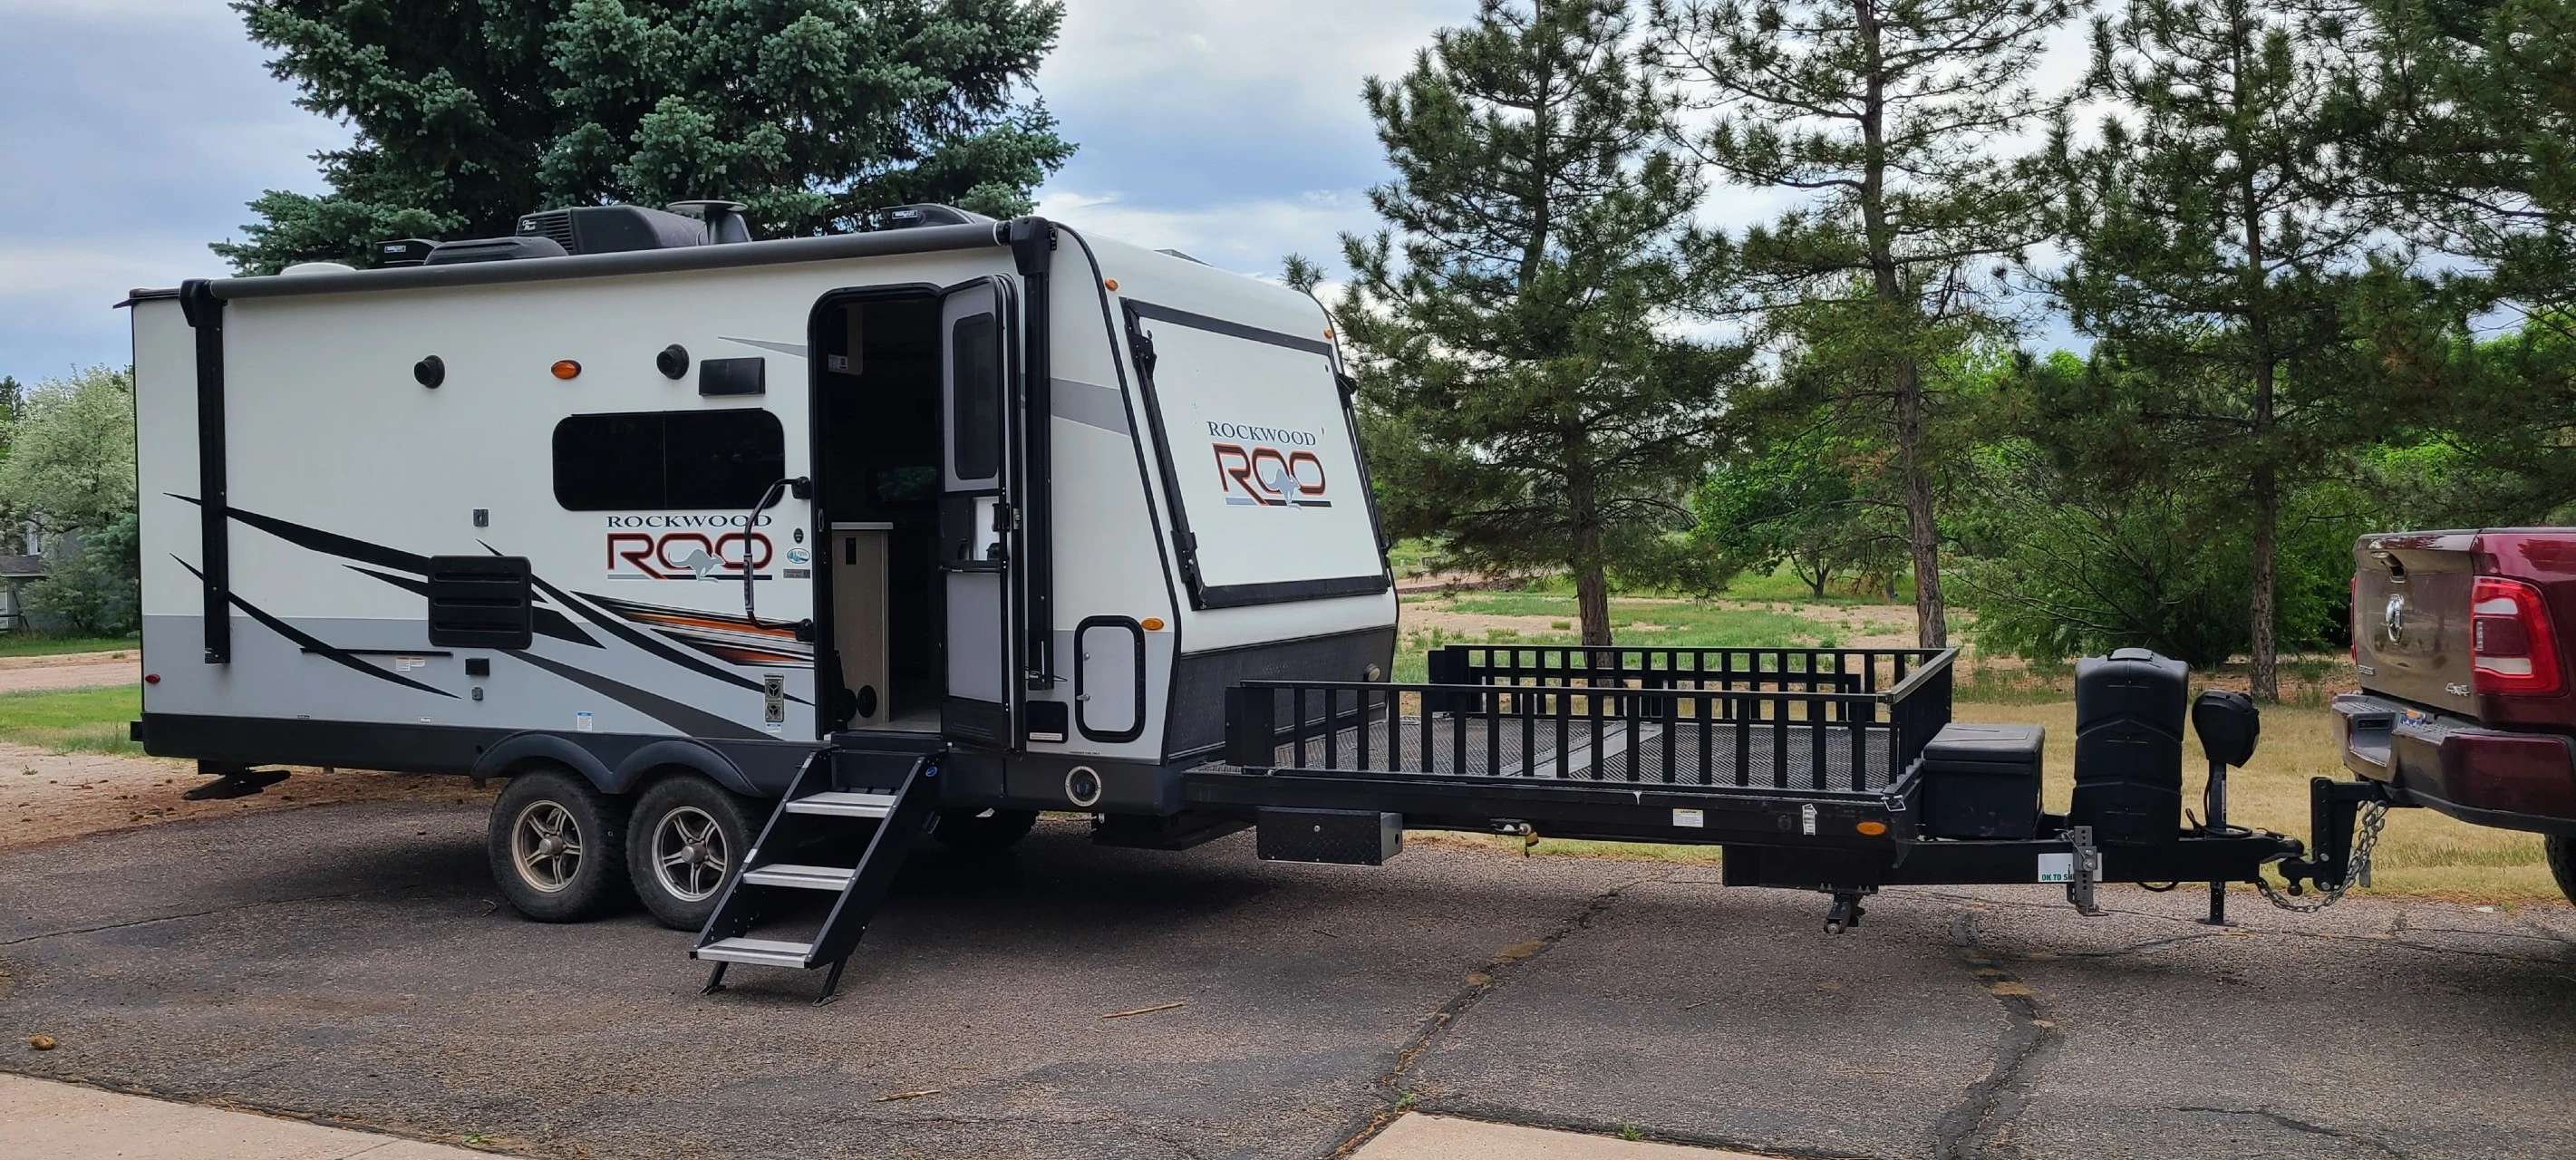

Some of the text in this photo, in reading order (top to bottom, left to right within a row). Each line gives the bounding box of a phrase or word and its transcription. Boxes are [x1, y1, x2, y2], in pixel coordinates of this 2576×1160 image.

[1206, 420, 1316, 446] ROCKWOOD
[1212, 442, 1326, 507] ROO
[606, 515, 773, 527] ROCKWOOD
[606, 532, 773, 580] ROO
[2041, 873, 2052, 881] OK
[2053, 873, 2062, 881] TO
